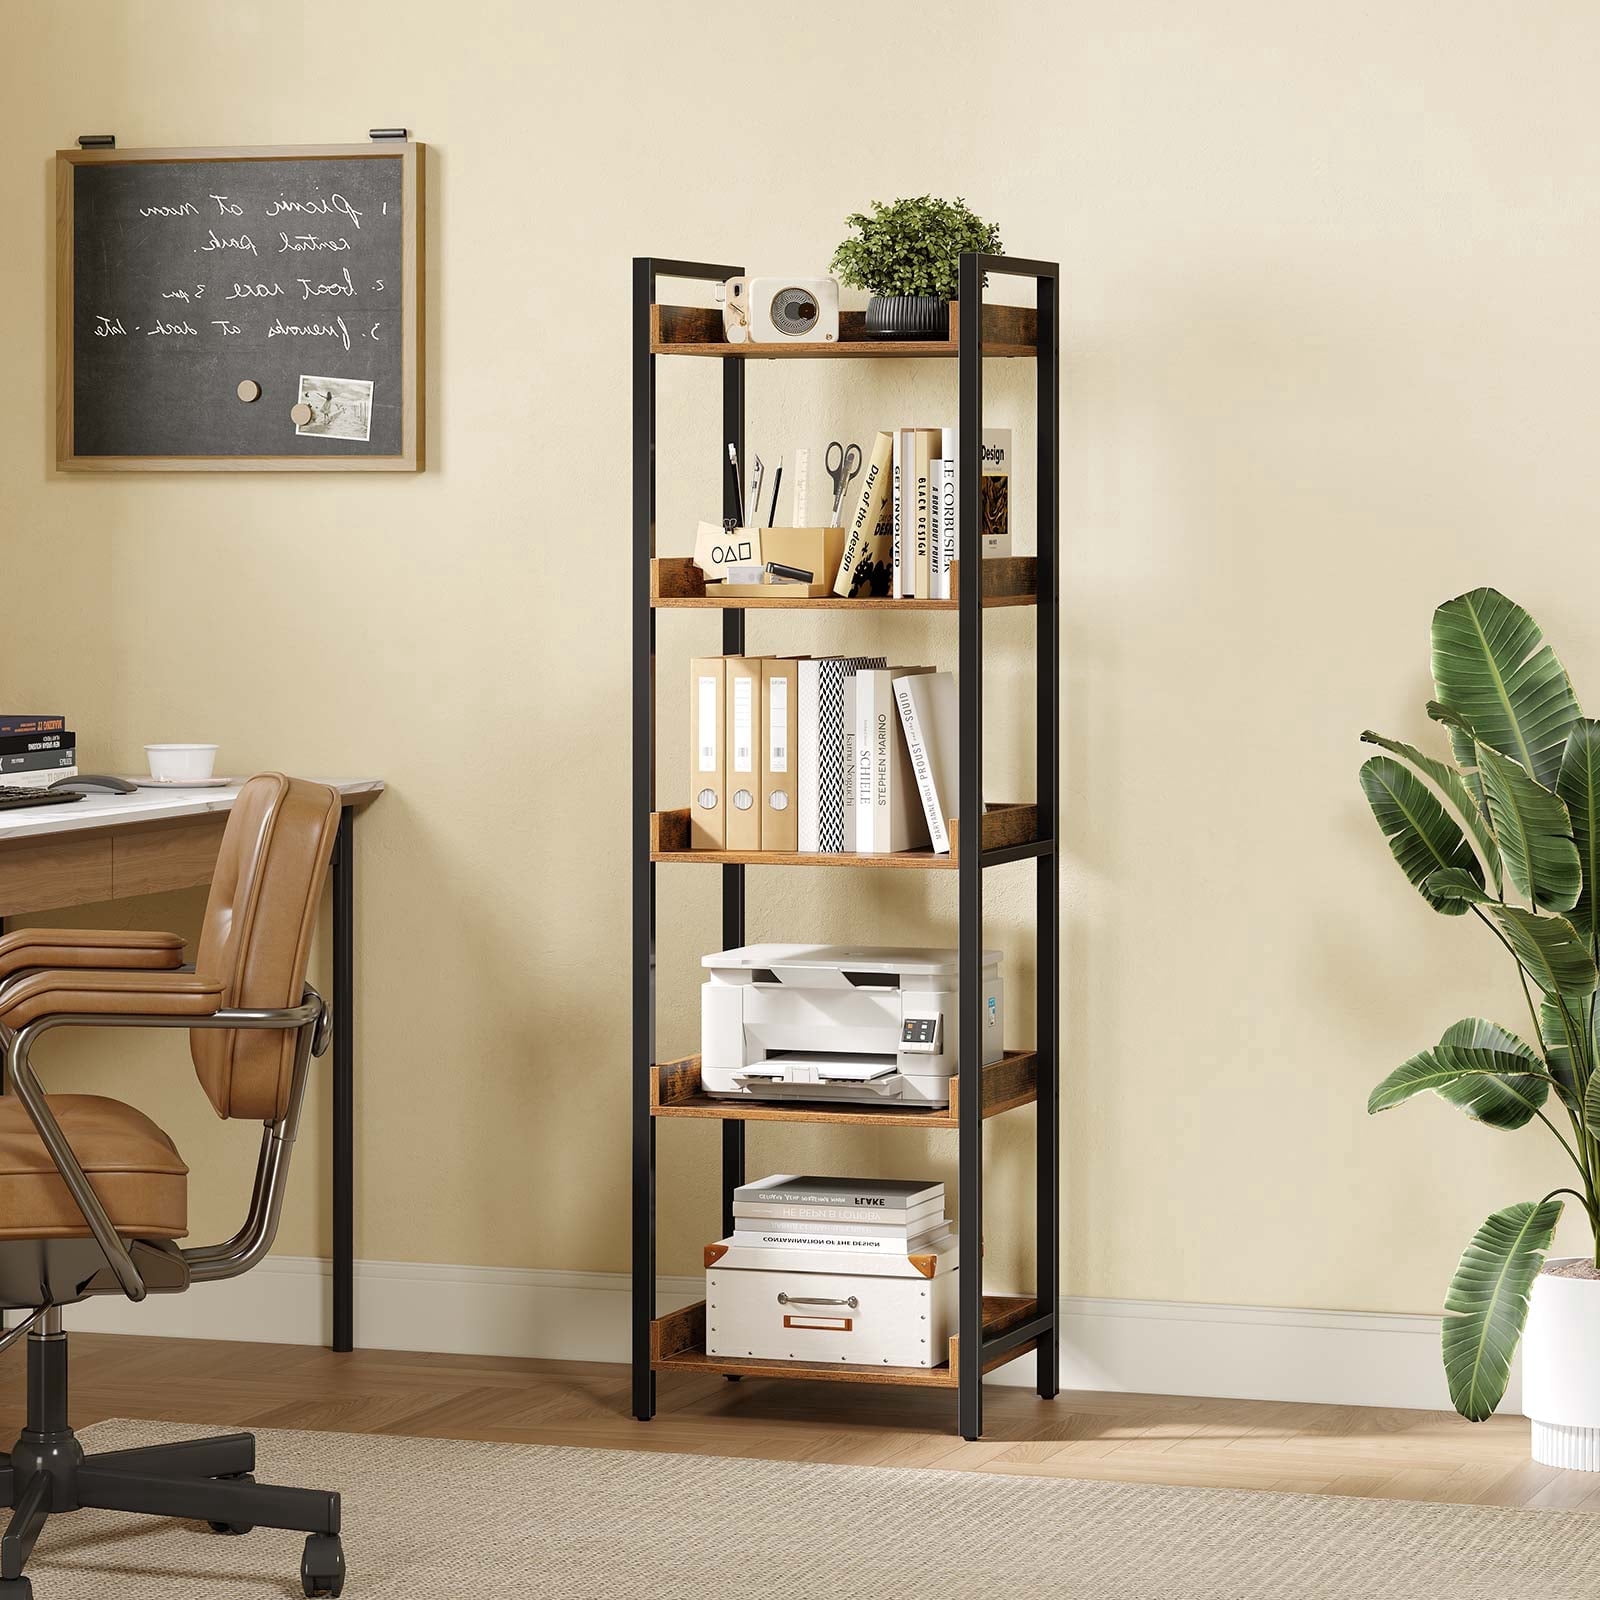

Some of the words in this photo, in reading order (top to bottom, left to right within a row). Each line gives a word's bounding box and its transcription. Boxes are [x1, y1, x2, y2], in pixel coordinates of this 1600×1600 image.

[944, 459, 954, 478] LE
[982, 444, 1005, 465] Design
[865, 464, 879, 490] Day
[918, 477, 927, 511] BLACK
[861, 492, 871, 508] of
[857, 508, 868, 529] the
[843, 530, 860, 573] design
[918, 517, 927, 556] DESIGN
[899, 692, 914, 722] SQUID
[846, 733, 855, 763] Isamu
[878, 714, 887, 755] MARINO
[860, 750, 871, 805] SCHIELE
[911, 743, 928, 780] PROUST
[846, 765, 855, 807] Noguchi
[878, 758, 887, 806] STEPHEN
